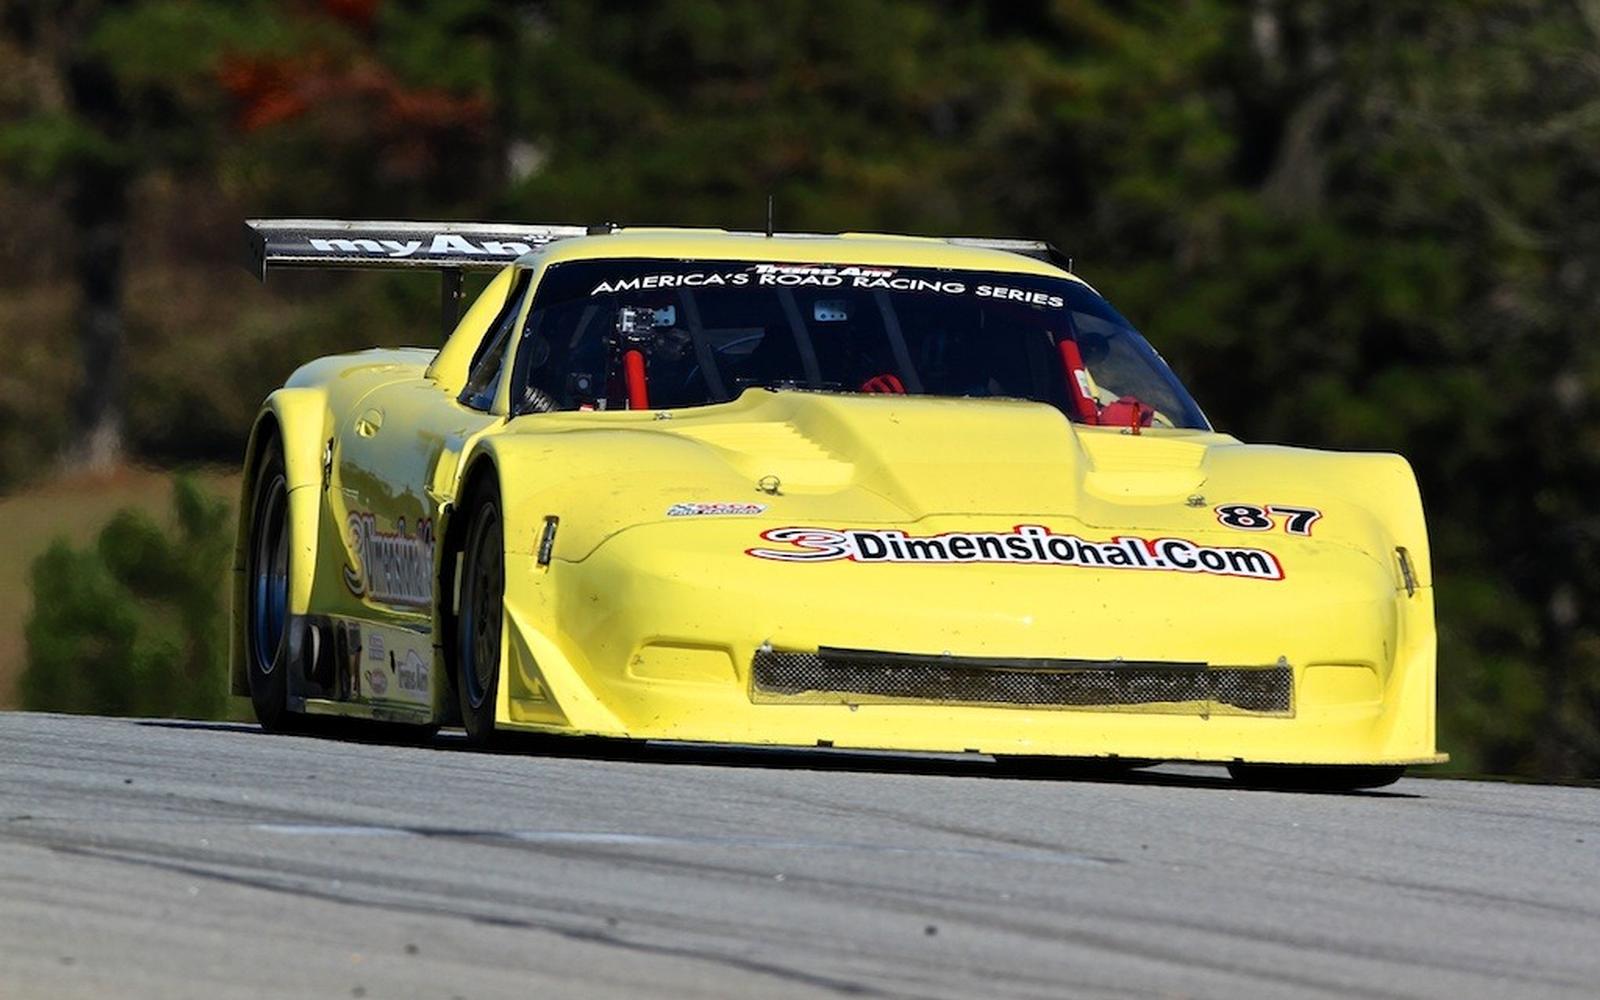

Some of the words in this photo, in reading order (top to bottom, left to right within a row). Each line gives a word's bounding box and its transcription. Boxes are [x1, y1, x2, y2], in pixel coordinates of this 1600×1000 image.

[309, 234, 545, 257] myAn
[838, 266, 893, 278] Am
[590, 273, 750, 297] AMERICA'S
[758, 273, 843, 287] ROAD
[852, 276, 966, 294] RACING
[975, 285, 1065, 308] SERIES
[1217, 504, 1321, 534] 87
[748, 526, 1276, 577] 3Dimensional.Com
